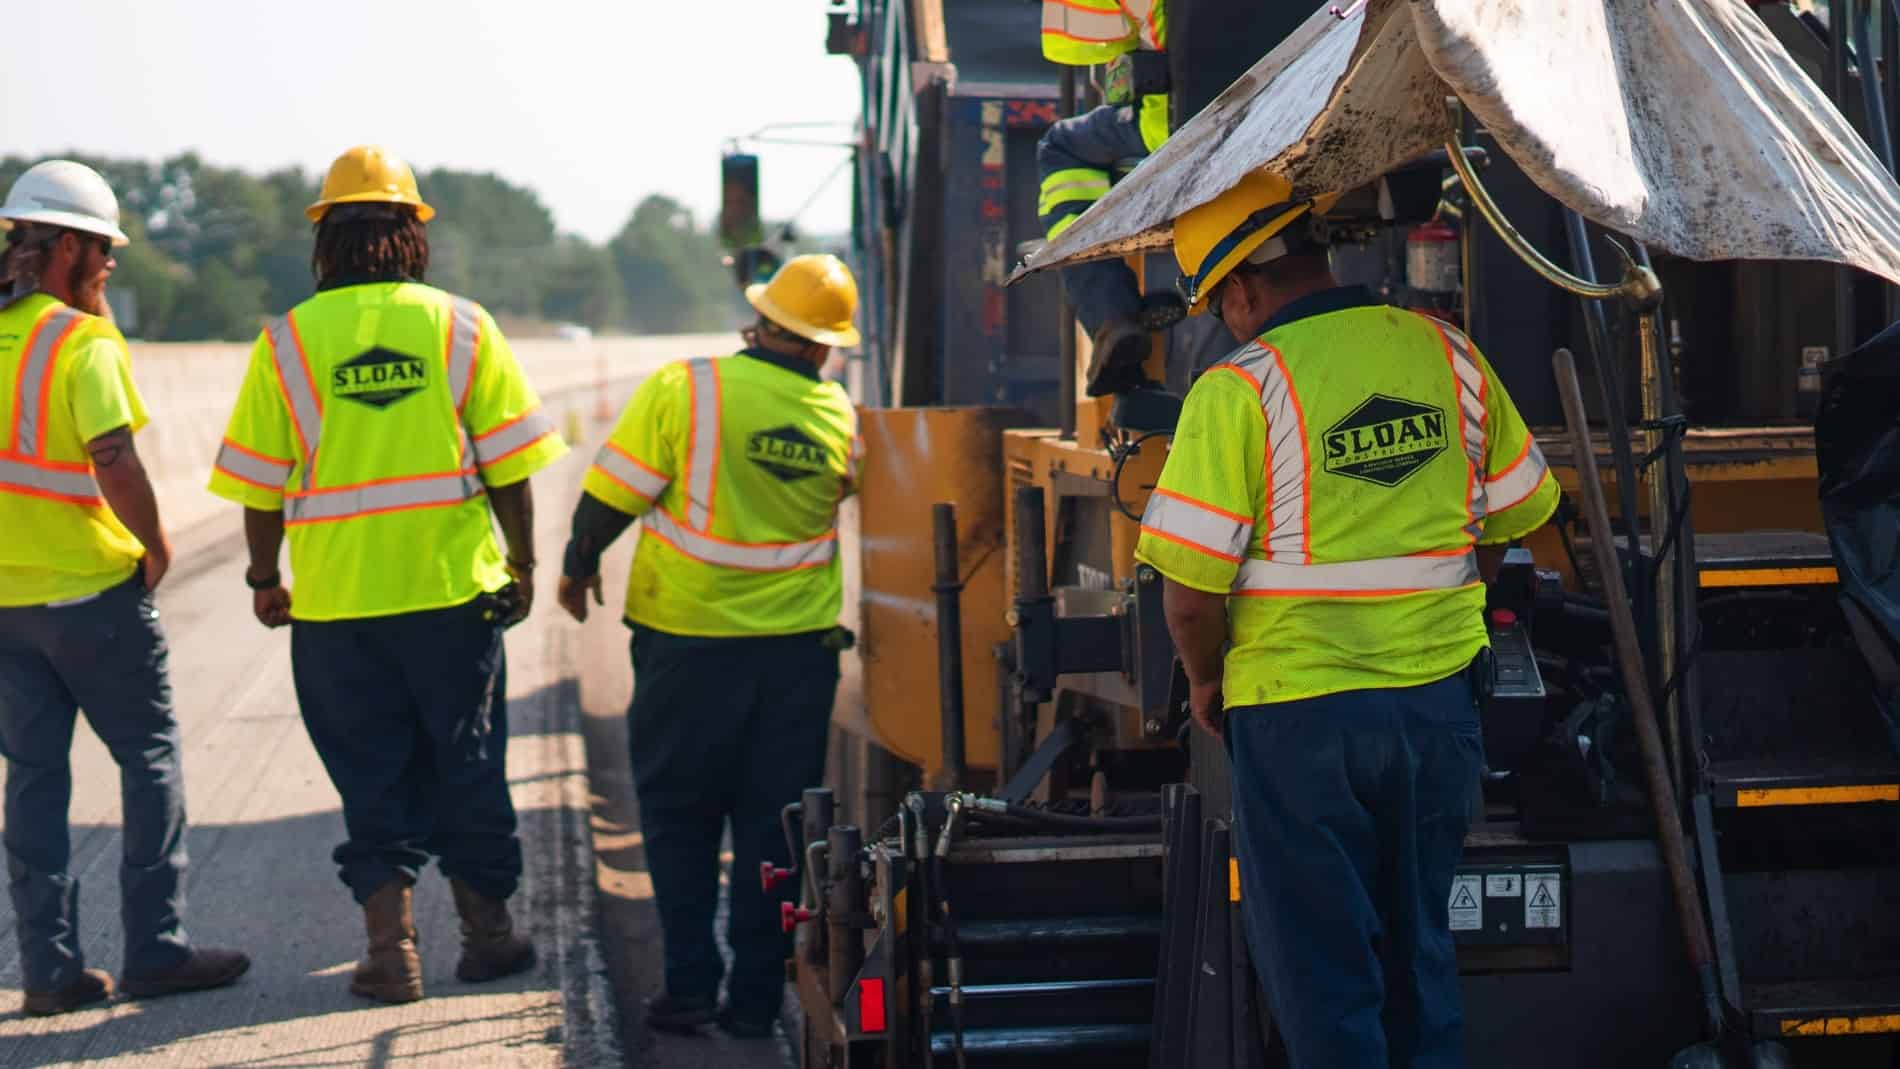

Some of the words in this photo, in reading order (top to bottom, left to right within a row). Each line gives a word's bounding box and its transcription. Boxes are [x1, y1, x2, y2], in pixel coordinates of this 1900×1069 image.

[336, 361, 424, 386] SLOAN
[1328, 414, 1441, 457] SLOAN
[749, 438, 825, 465] SLOAN
[1336, 440, 1440, 465] CONSTRUCTION
